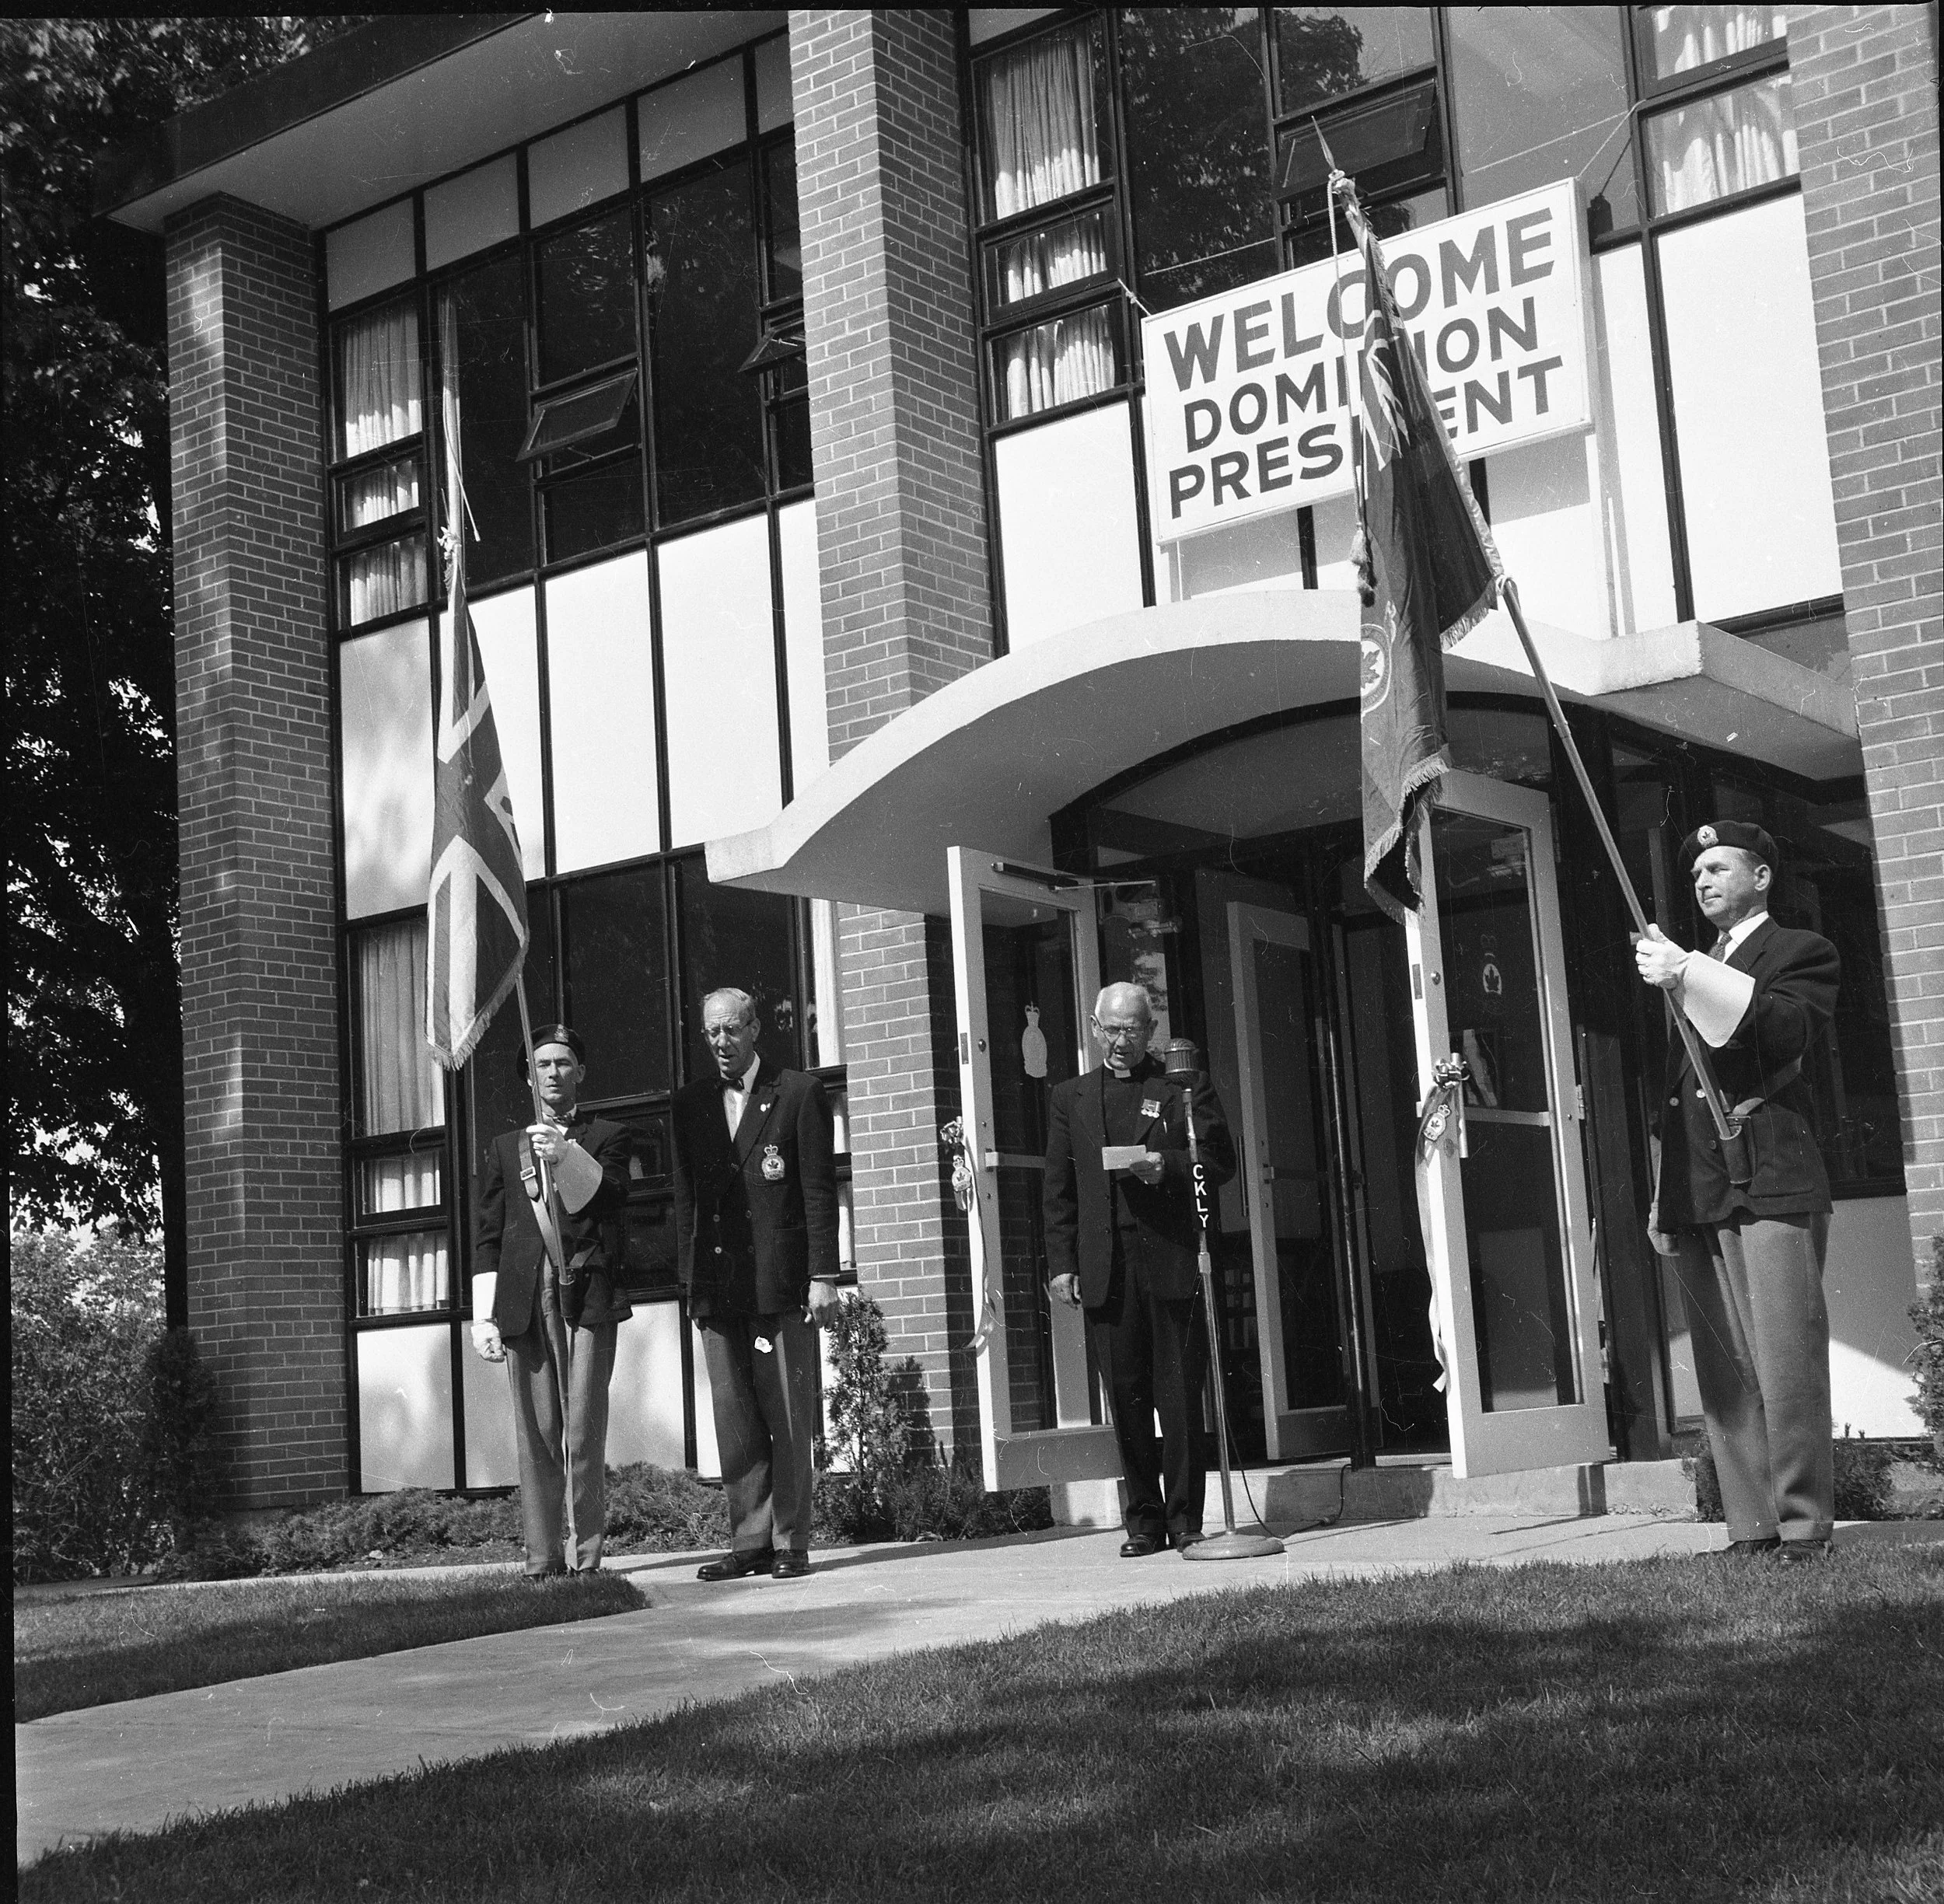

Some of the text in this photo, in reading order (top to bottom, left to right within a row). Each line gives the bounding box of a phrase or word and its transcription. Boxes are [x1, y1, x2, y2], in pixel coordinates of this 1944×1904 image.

[1163, 207, 1554, 392] WELCOME
[1184, 296, 1538, 454] DOMIION
[1169, 355, 1563, 520] PRESINT
[1192, 1164, 1208, 1228] CKLY
